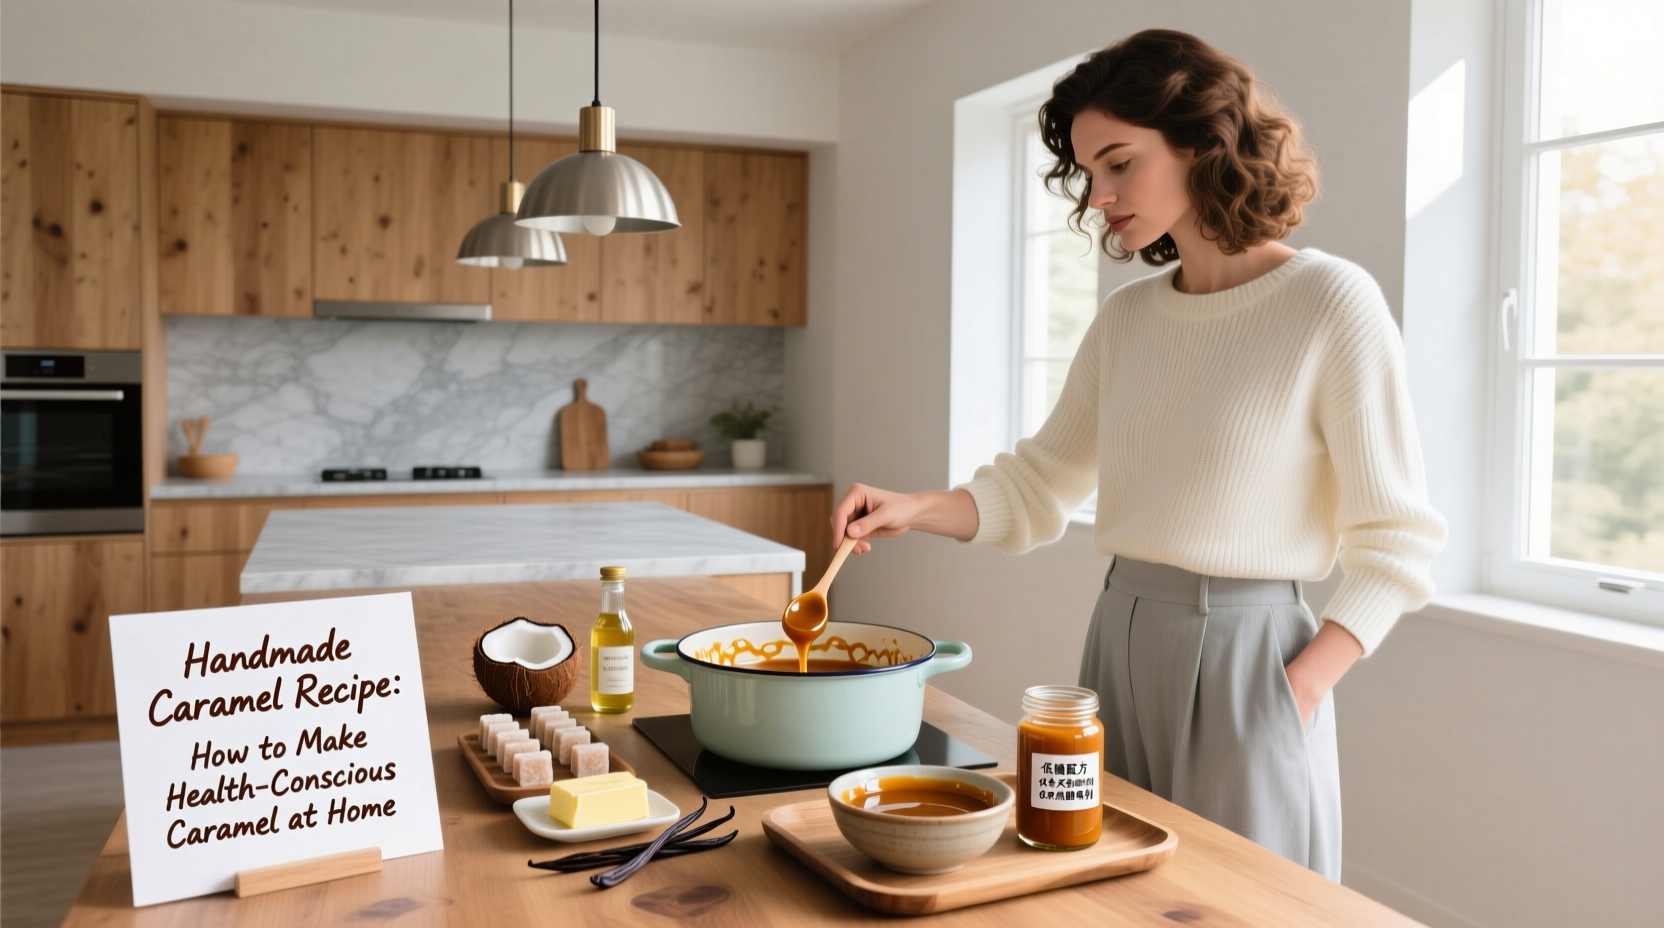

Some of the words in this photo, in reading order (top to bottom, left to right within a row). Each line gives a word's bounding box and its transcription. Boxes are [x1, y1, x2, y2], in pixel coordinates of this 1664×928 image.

[183, 627, 352, 680] Handmade
[148, 676, 284, 727] Caramel
[294, 673, 401, 715] Recipe:
[190, 740, 249, 771] How
[258, 735, 287, 761] to
[295, 723, 368, 757] Make
[166, 762, 396, 812] Health-Conscious
[166, 805, 280, 849] Caramel
[288, 802, 318, 830] at
[327, 796, 397, 826] Home
